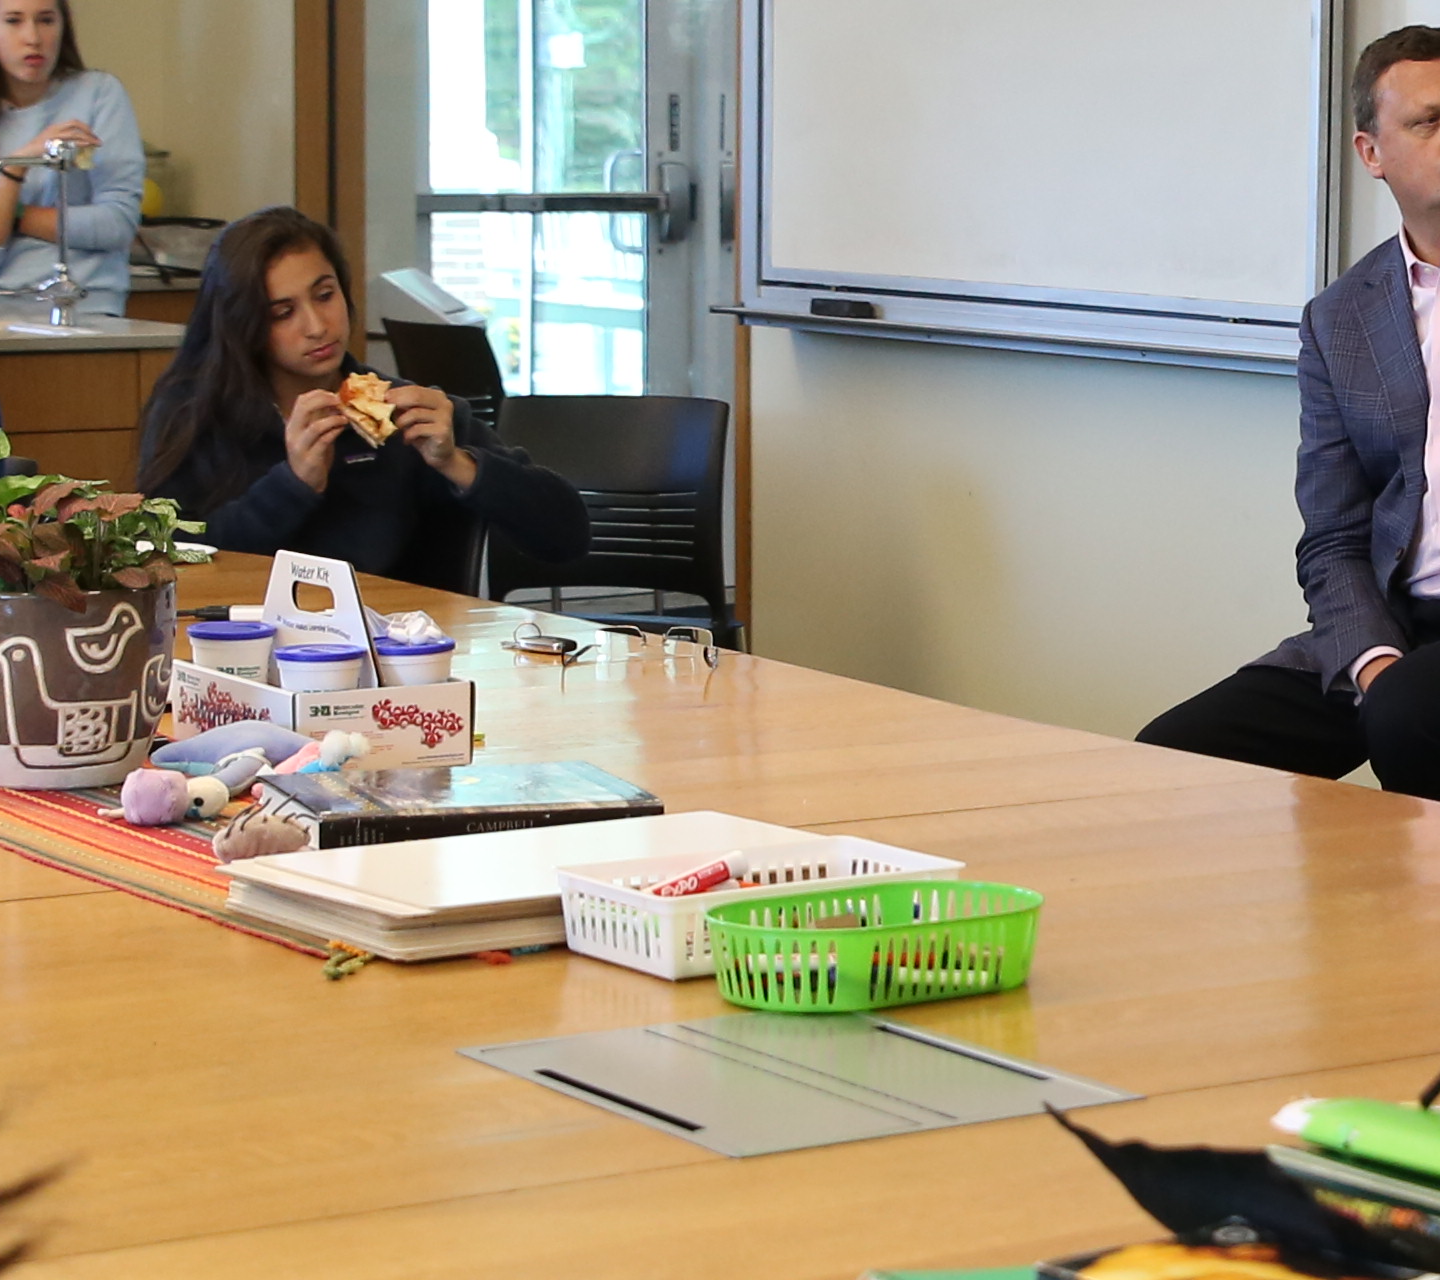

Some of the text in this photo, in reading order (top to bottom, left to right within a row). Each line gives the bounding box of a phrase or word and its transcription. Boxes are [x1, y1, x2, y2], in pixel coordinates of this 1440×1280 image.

[291, 562, 330, 583] Water Kit
[466, 819, 534, 833] CAMPBELL
[661, 875, 698, 897] EXPO
